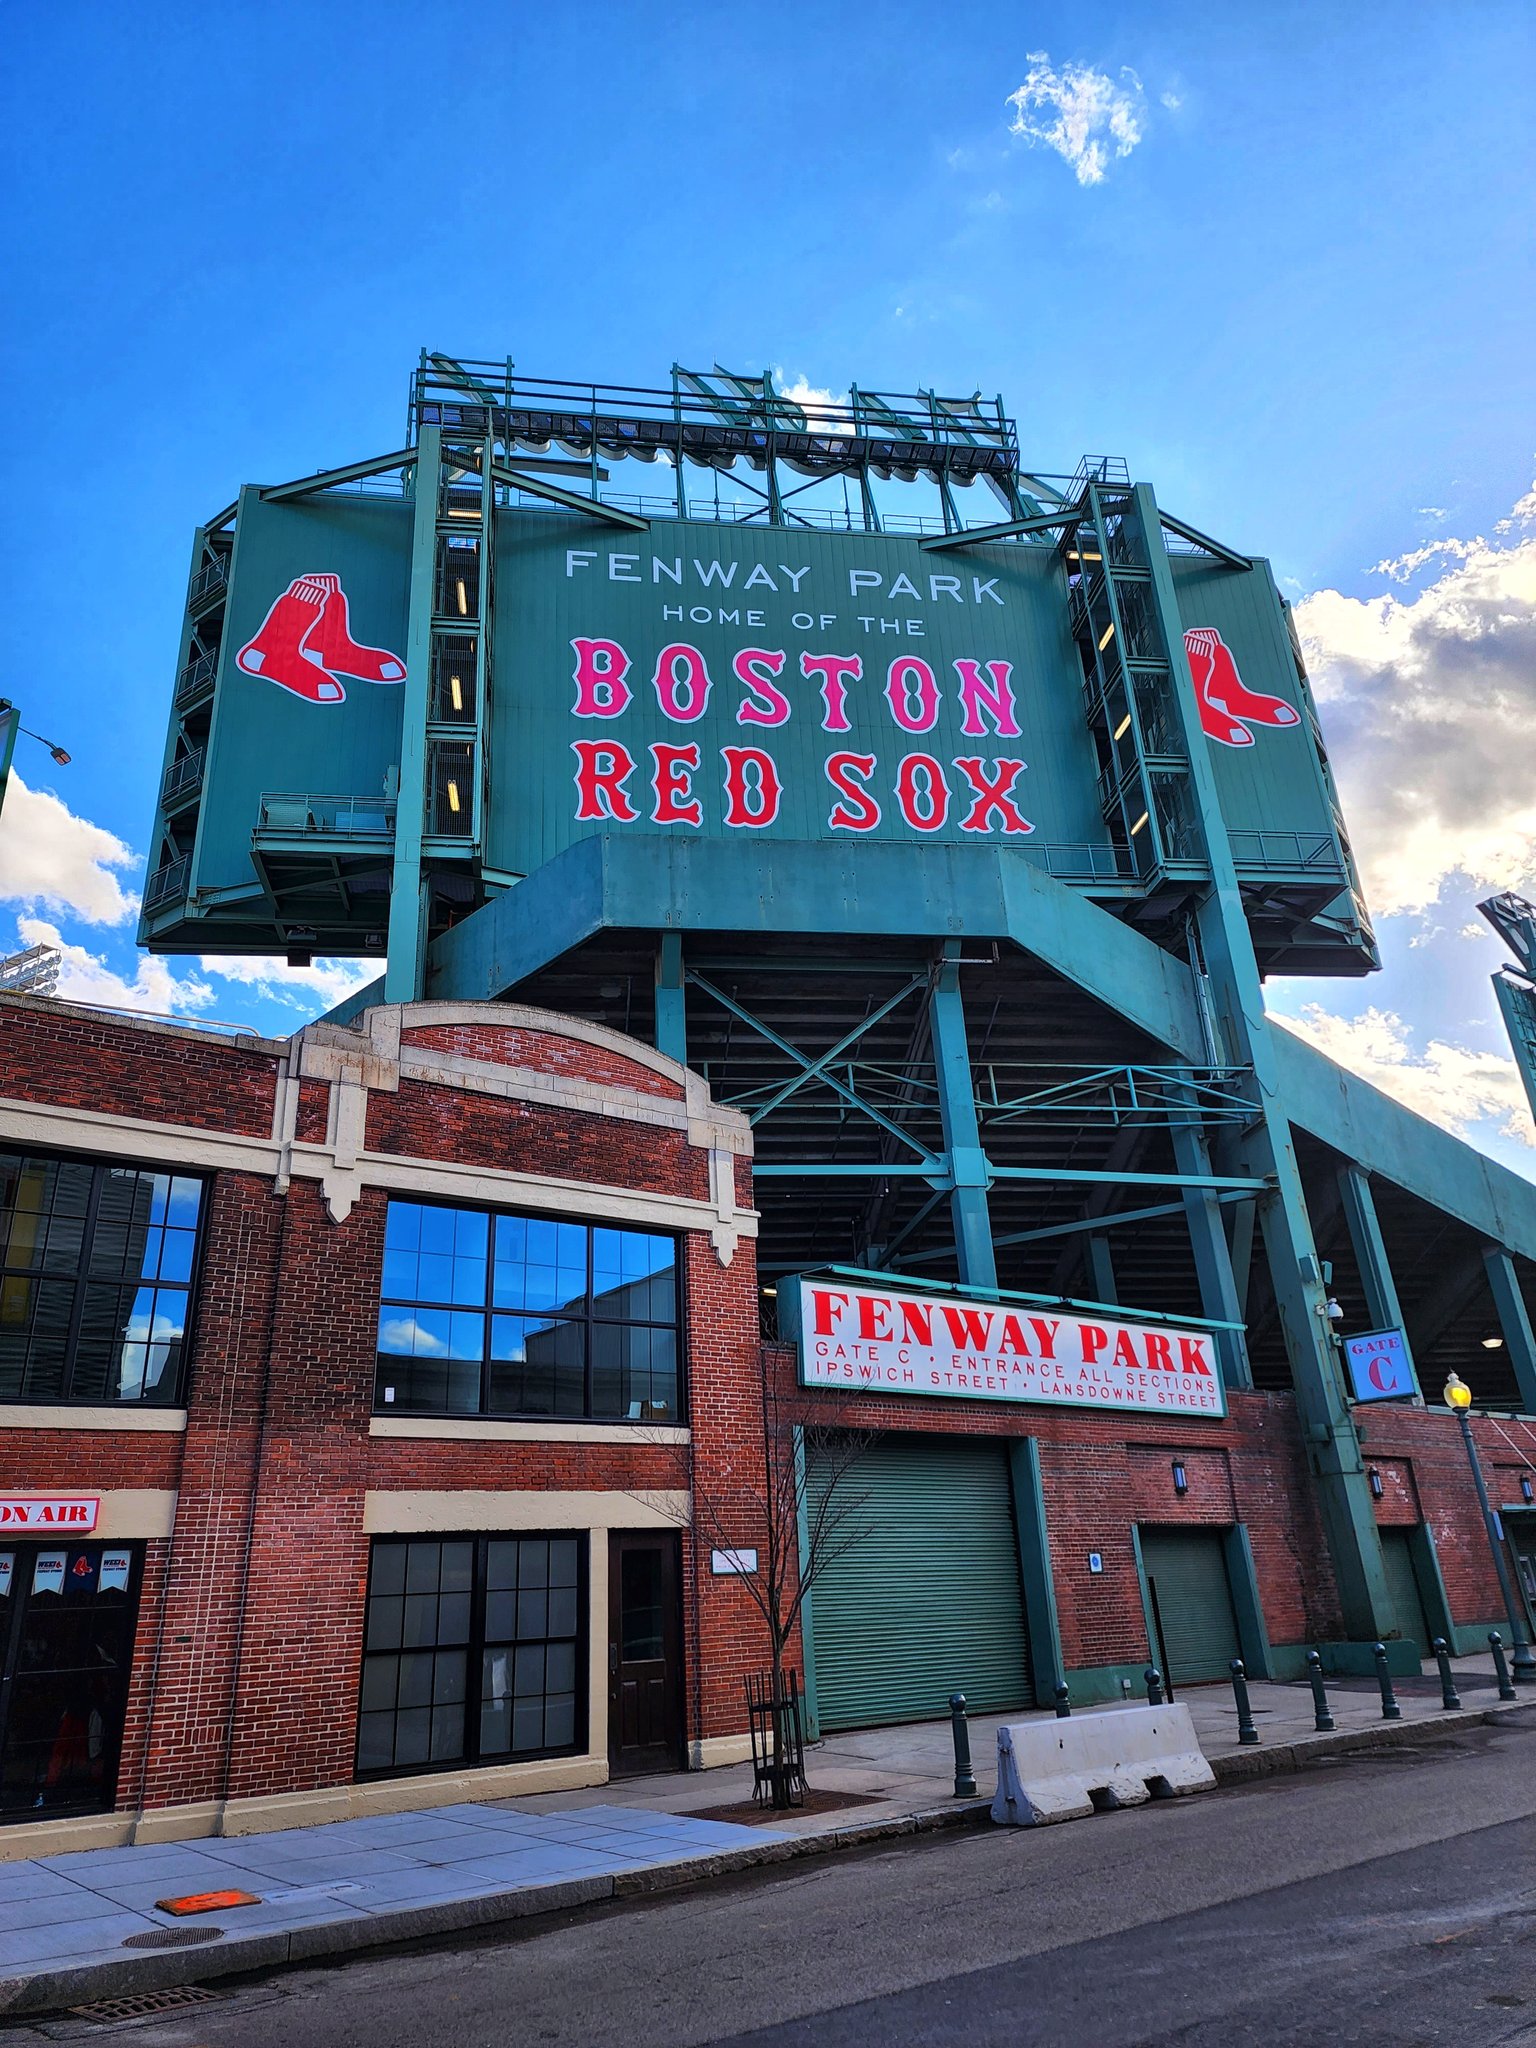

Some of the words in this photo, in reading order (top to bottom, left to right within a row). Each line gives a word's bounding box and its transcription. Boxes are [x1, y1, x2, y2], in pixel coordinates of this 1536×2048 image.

[566, 550, 811, 593] FENWAY
[850, 569, 1005, 605] PARK
[663, 604, 766, 627] HOME
[791, 613, 837, 630] OF
[857, 616, 925, 636] THE
[569, 636, 1024, 738] BOSTON
[569, 739, 785, 829] RED
[824, 750, 1036, 835] SOX
[812, 1290, 1060, 1360] FENWAY
[1078, 1323, 1212, 1376] PARK
[1352, 1337, 1400, 1355] GATE
[815, 1341, 879, 1361] GATE
[898, 1349, 910, 1364] C
[952, 1354, 1064, 1379] ENTRANCE
[1080, 1369, 1112, 1383] ALL
[1126, 1372, 1215, 1392] SECTIONS
[817, 1361, 914, 1382] IPSWICH
[931, 1371, 1008, 1390] STREET
[1041, 1383, 1146, 1402] LANSDOWNE
[1157, 1391, 1216, 1407] STREET
[1369, 1356, 1397, 1391] C
[36, 1506, 88, 1522] AIR
